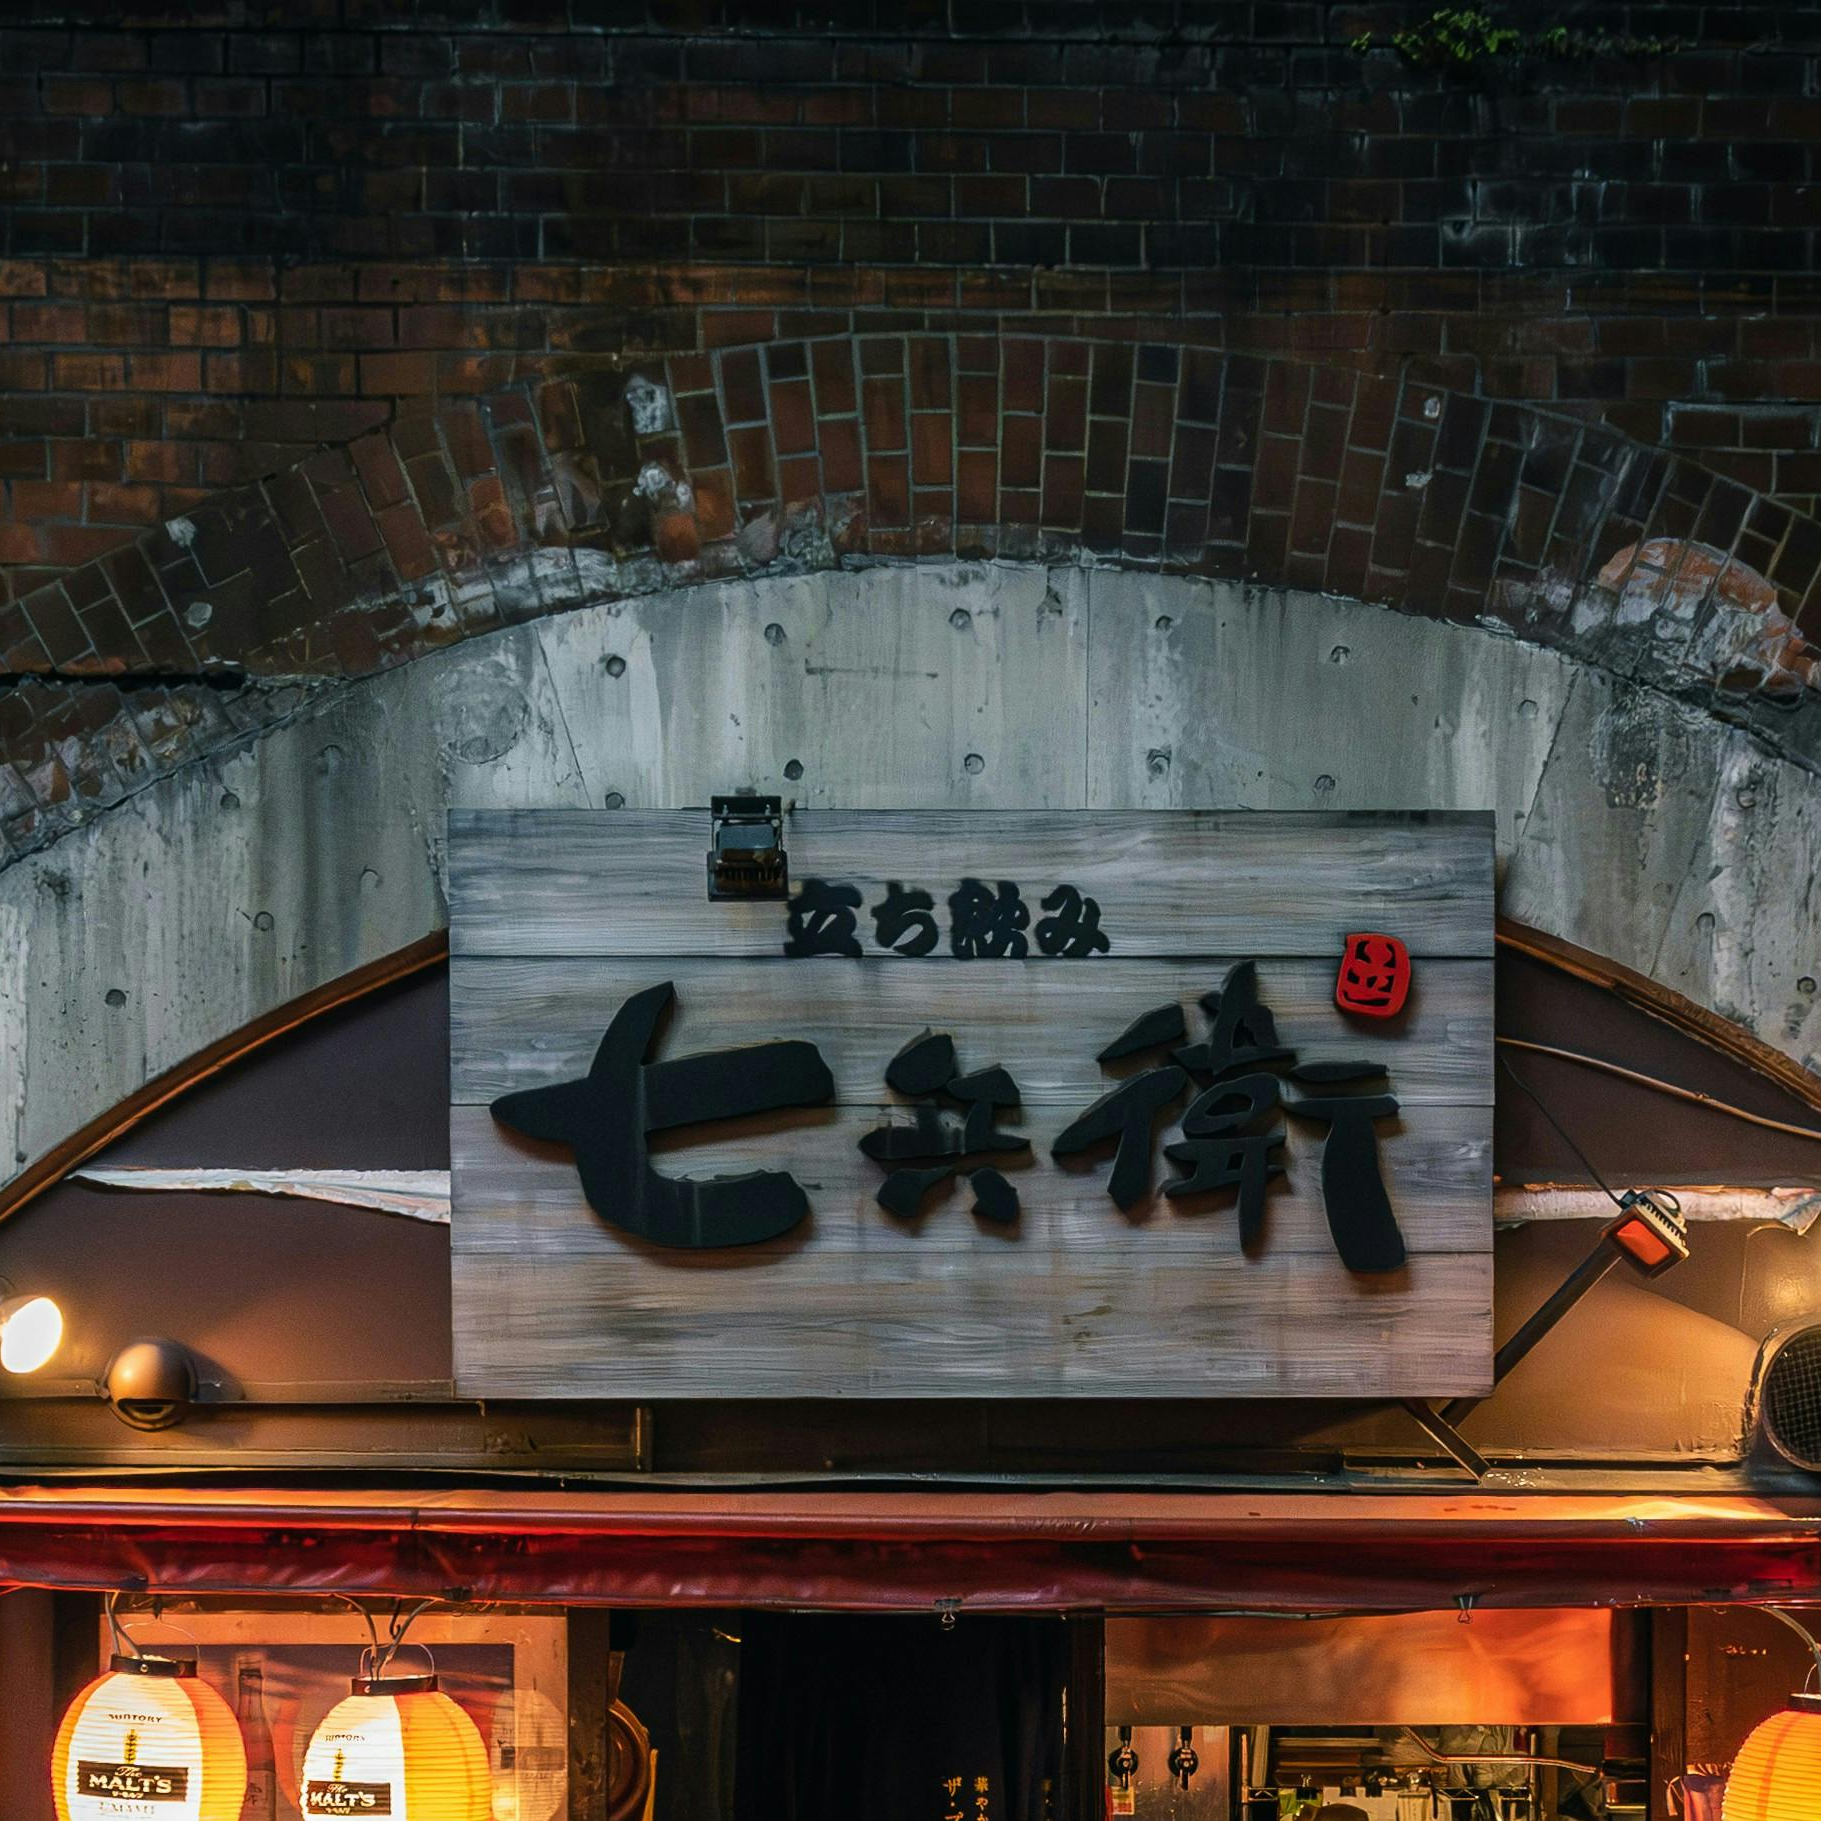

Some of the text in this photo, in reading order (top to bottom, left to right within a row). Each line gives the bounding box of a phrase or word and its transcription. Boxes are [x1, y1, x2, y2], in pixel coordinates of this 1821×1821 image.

[783, 878, 1110, 959] 立ち飲み
[490, 959, 1405, 1272] 七兵衛
[109, 1713, 162, 1723] SUNTORY
[115, 1766, 142, 1777] The
[89, 1774, 172, 1793] MALT'S
[310, 1791, 375, 1807] MALT'S
